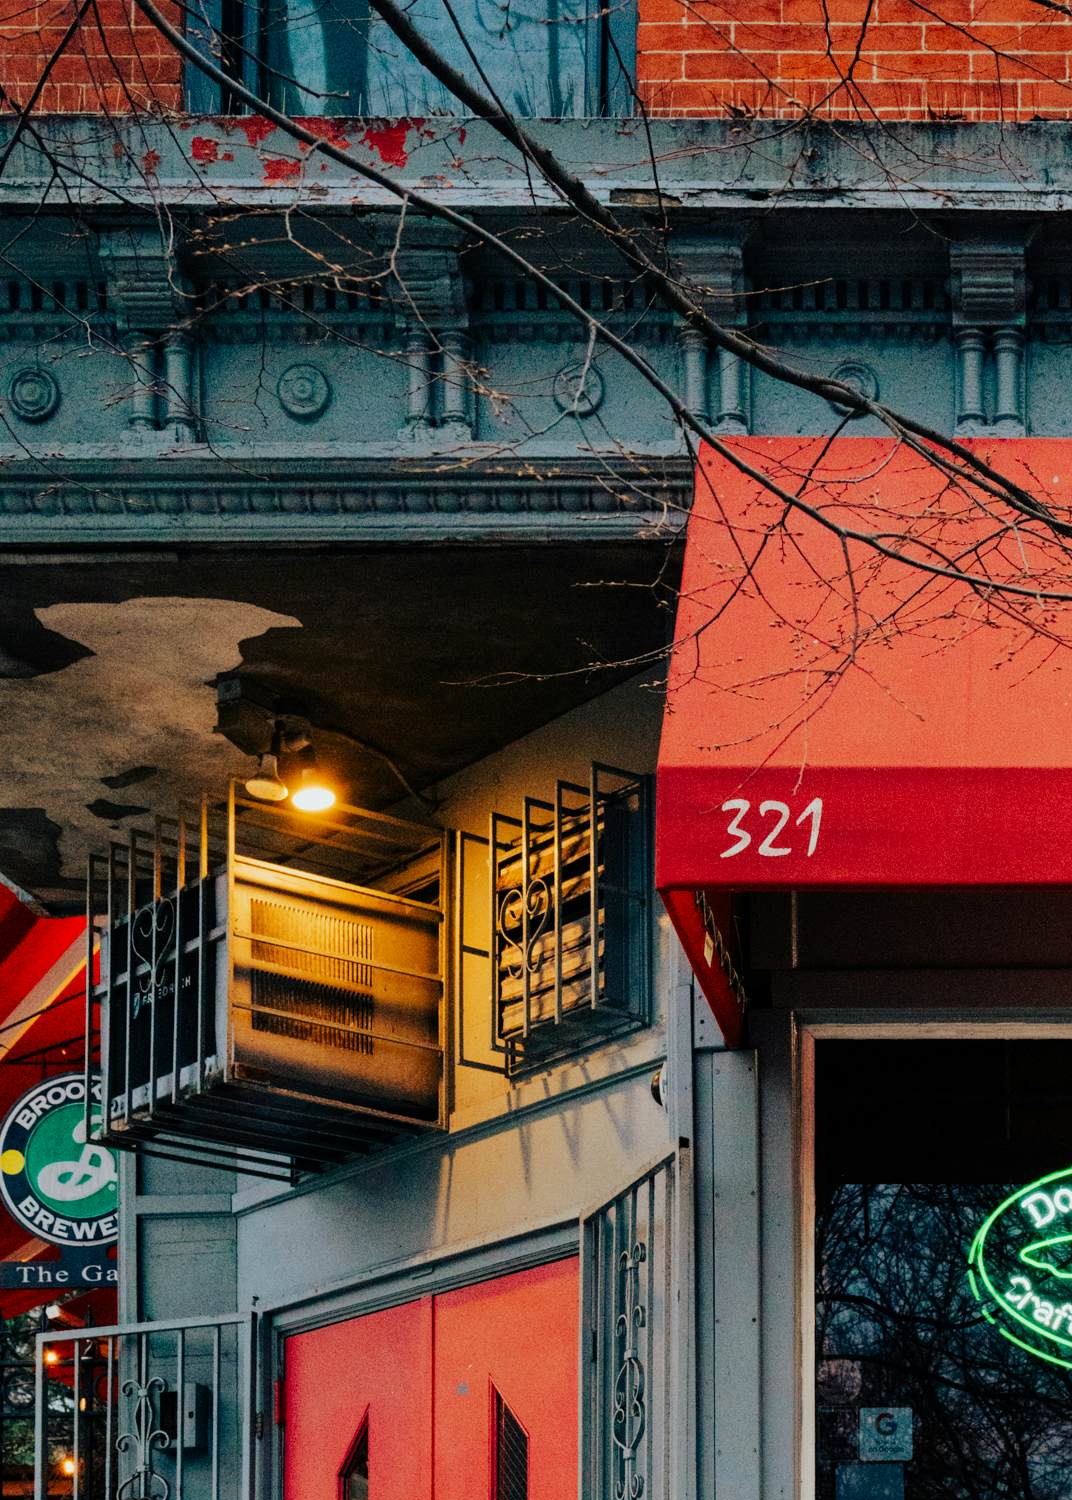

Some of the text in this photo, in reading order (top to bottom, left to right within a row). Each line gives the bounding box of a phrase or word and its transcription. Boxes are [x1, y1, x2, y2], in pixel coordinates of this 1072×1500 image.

[720, 797, 823, 858] 321
[18, 1194, 118, 1240] BREWE
[16, 1264, 118, 1283] The Ga
